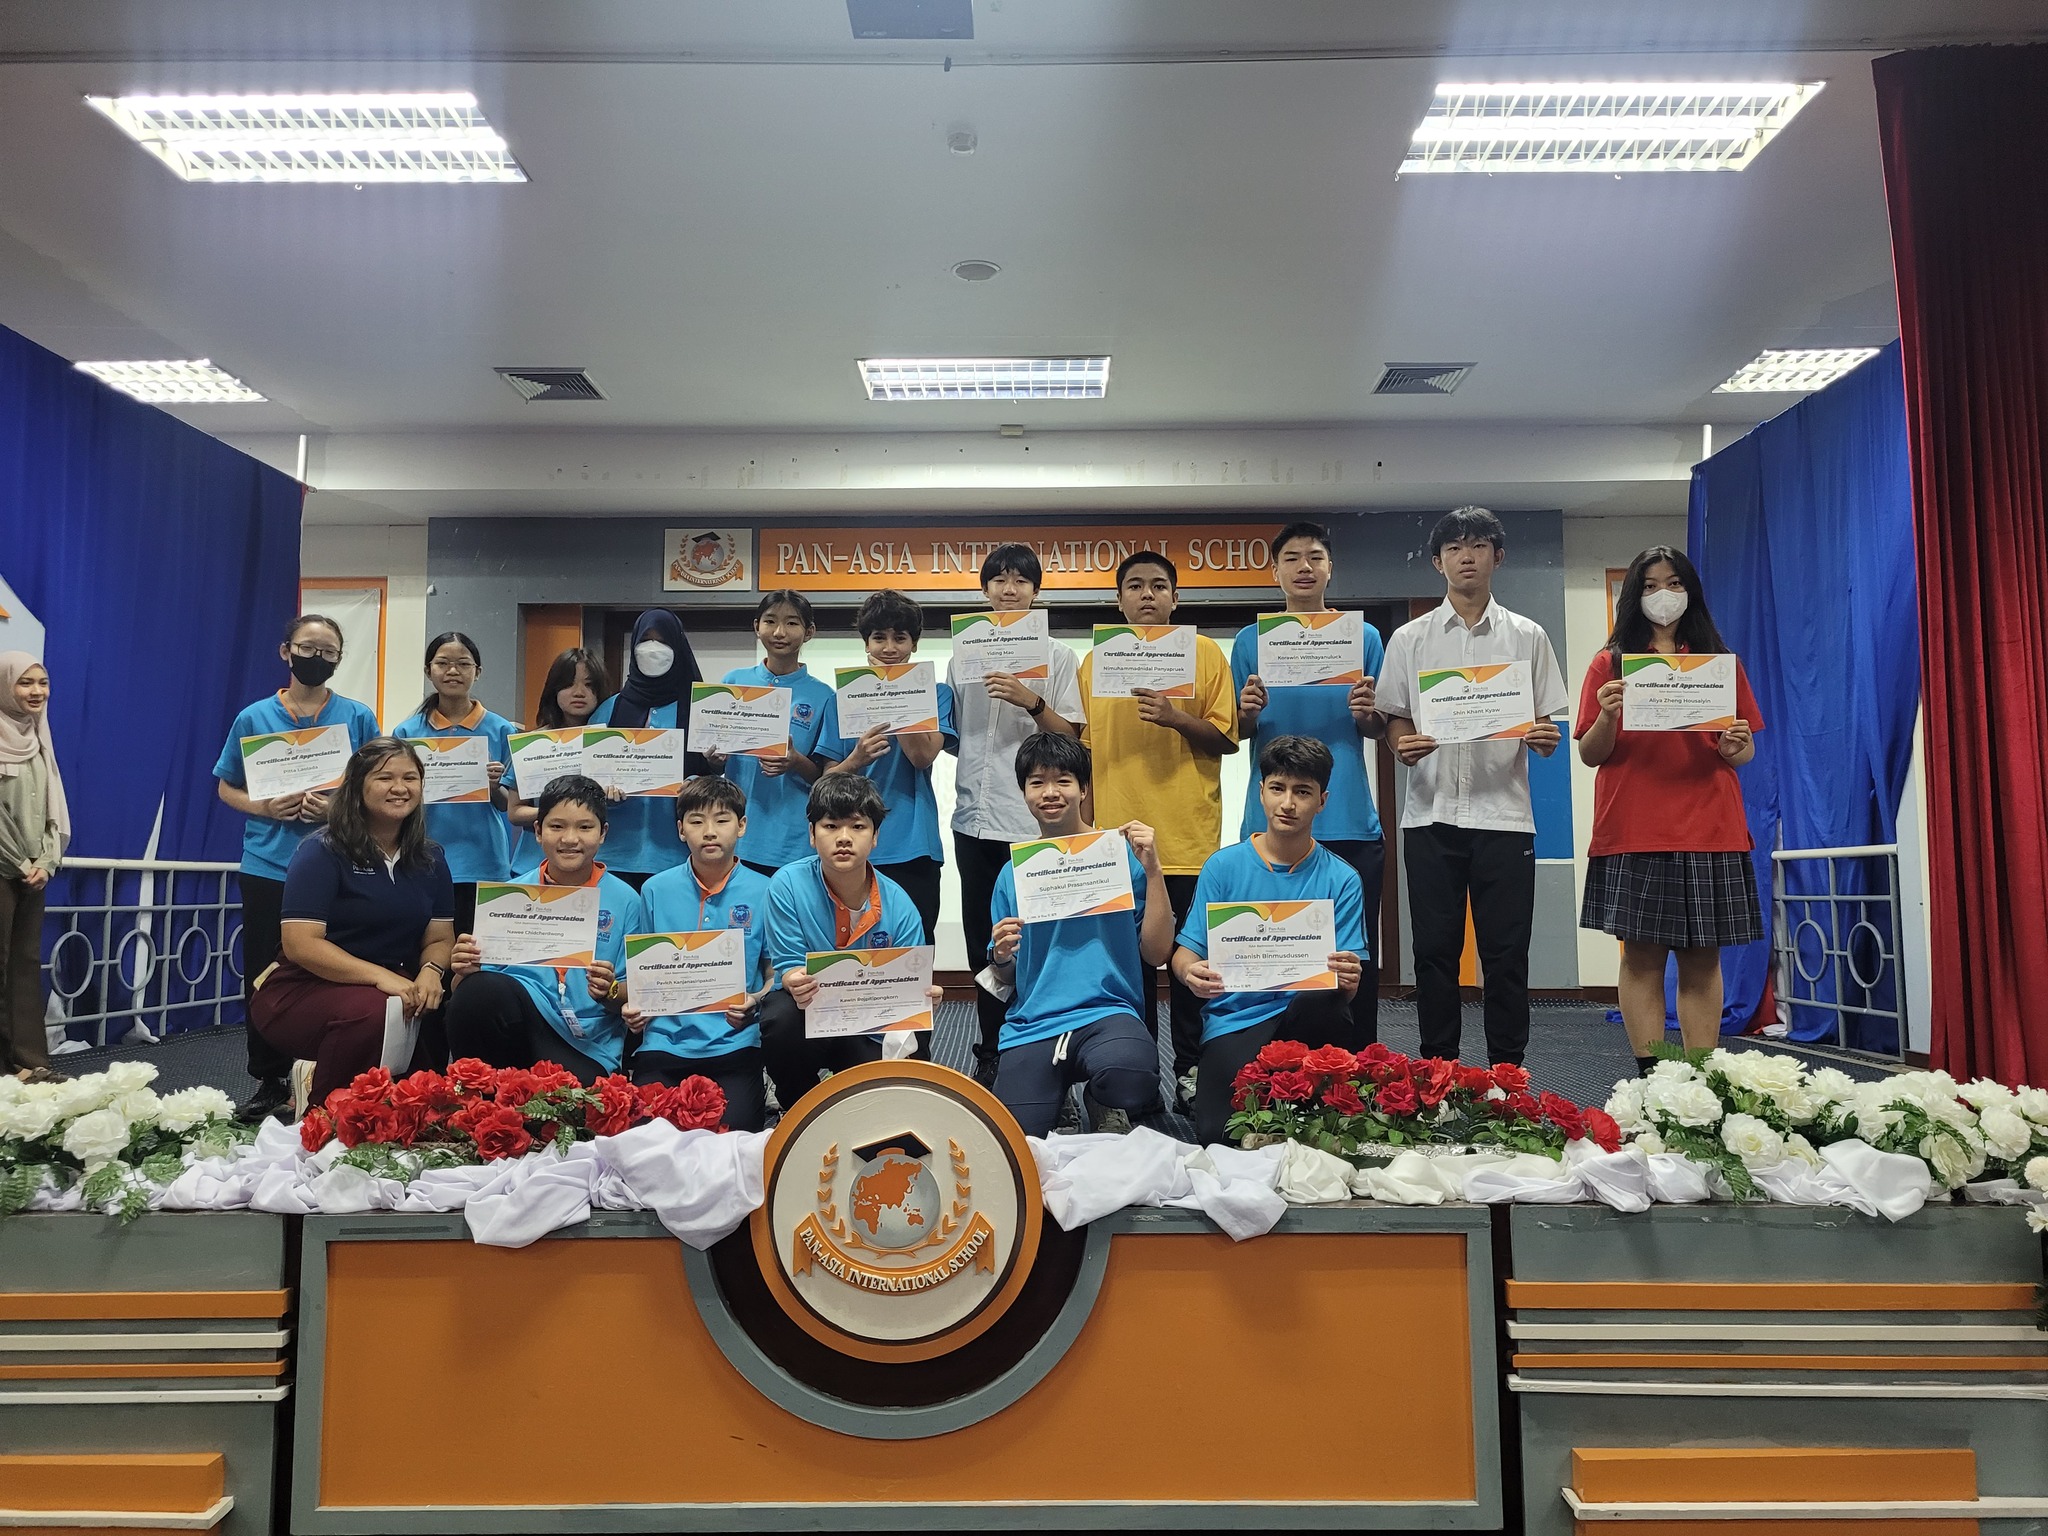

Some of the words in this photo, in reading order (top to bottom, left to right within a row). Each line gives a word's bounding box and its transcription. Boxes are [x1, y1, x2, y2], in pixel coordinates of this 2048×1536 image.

[777, 541, 917, 574] PAN-ASIA
[931, 539, 1175, 574] INTNATIONL
[1188, 538, 1270, 571] SCHO
[1431, 695, 1466, 703] Certificate
[1476, 691, 1521, 699] Appreciation
[256, 757, 290, 765] Certificate
[299, 750, 340, 759] Appreciation
[1026, 868, 1062, 878] Certificate
[1071, 861, 1116, 872] Appreciation
[1039, 884, 1066, 892] Suphakul
[1068, 879, 1109, 888] Prasansantikul
[537, 914, 585, 922] Appreciation
[1271, 934, 1321, 942] Appreciation
[870, 976, 919, 985] Appreciation
[800, 1226, 845, 1278] PAN-ASIA
[845, 1265, 950, 1292] INTERNATIONAL
[947, 1227, 990, 1274] SCHOOL
